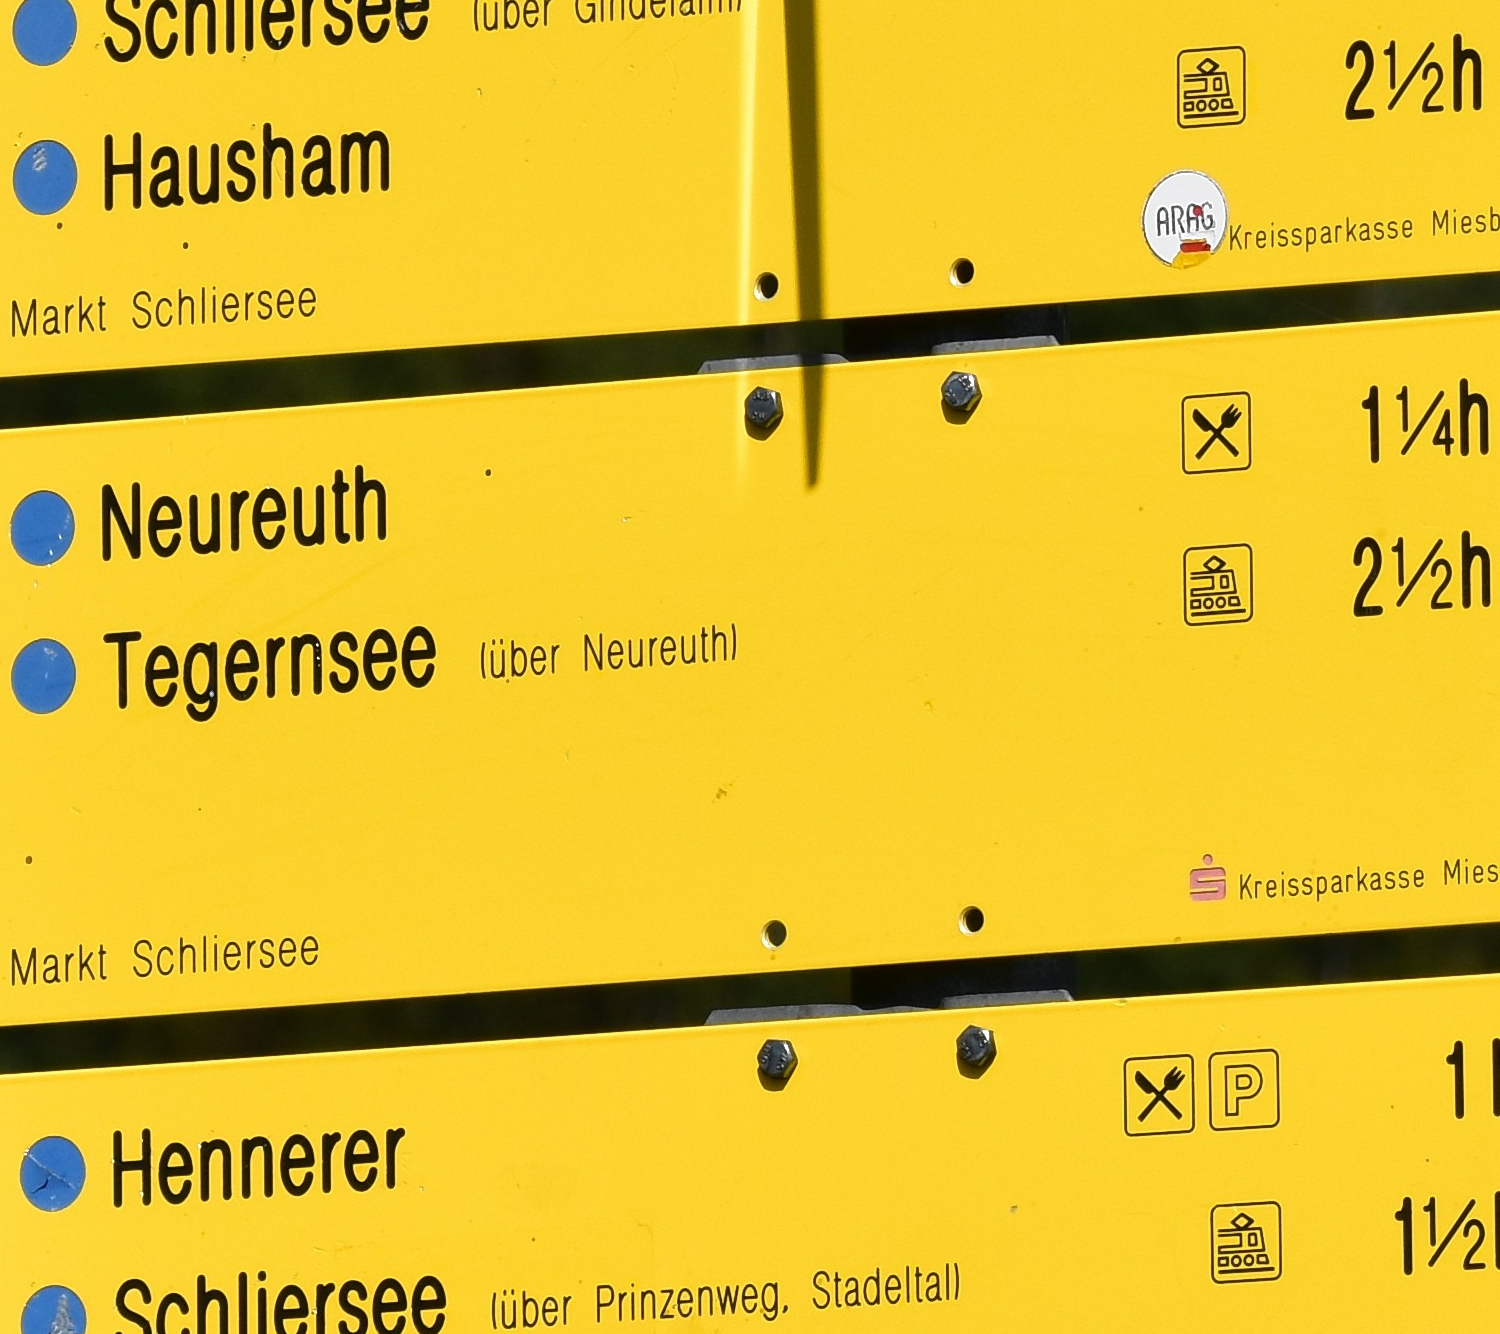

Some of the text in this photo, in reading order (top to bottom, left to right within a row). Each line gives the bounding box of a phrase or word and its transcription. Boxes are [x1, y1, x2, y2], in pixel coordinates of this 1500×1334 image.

[104, 122, 390, 212] Hausham
[1156, 200, 1215, 237] ARAG
[1229, 216, 1413, 253] Kreissparkasse
[11, 286, 317, 338] Markt Schliersee
[101, 464, 387, 562] Neureuth
[102, 623, 737, 723] Tegernsee (über Neureuth)
[1239, 865, 1425, 902] Kreissparkasse
[11, 935, 319, 987] Markt Schliersee
[112, 1127, 406, 1209] Hennerer
[491, 1290, 573, 1330] (über
[596, 1281, 789, 1324] Prinzenweg,
[812, 1262, 960, 1310] Stadeltal)
